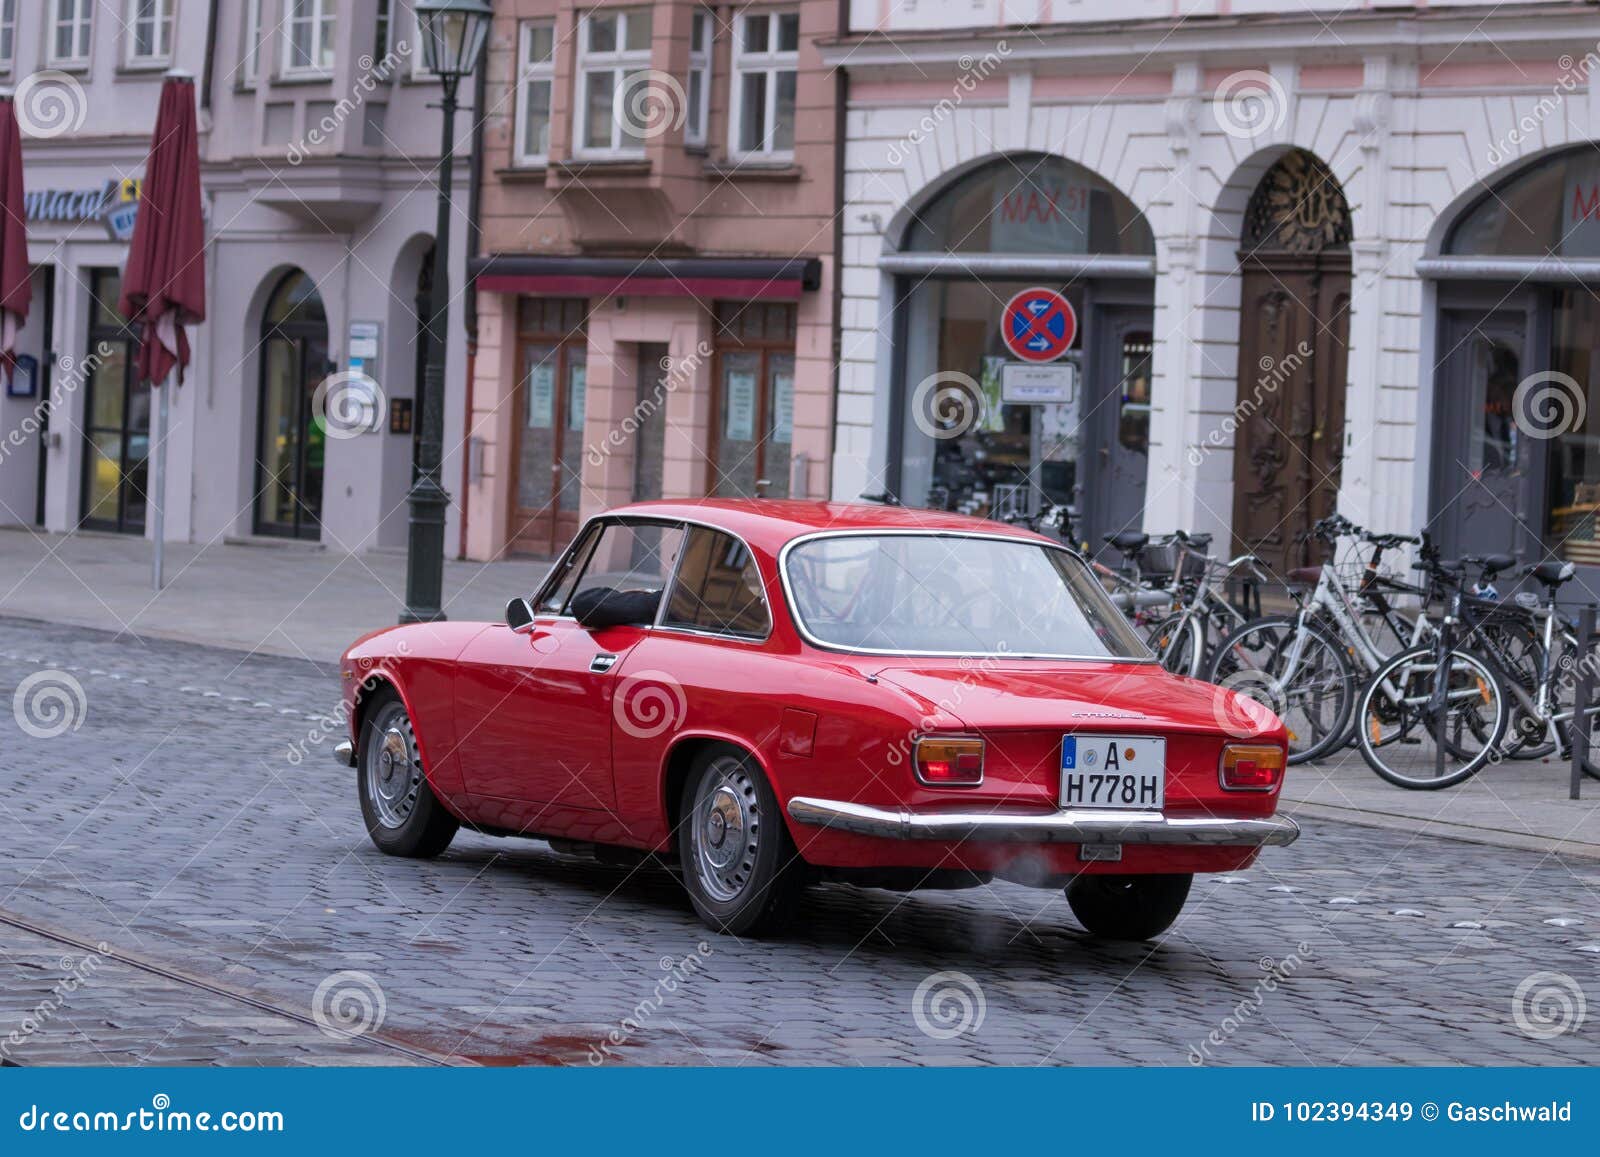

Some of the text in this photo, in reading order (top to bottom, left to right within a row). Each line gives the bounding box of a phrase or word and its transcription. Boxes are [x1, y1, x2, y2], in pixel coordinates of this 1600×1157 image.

[1000, 187, 1062, 224] MAX
[1066, 756, 1073, 765] D
[1104, 741, 1119, 770] A
[1066, 774, 1157, 804] H778H
